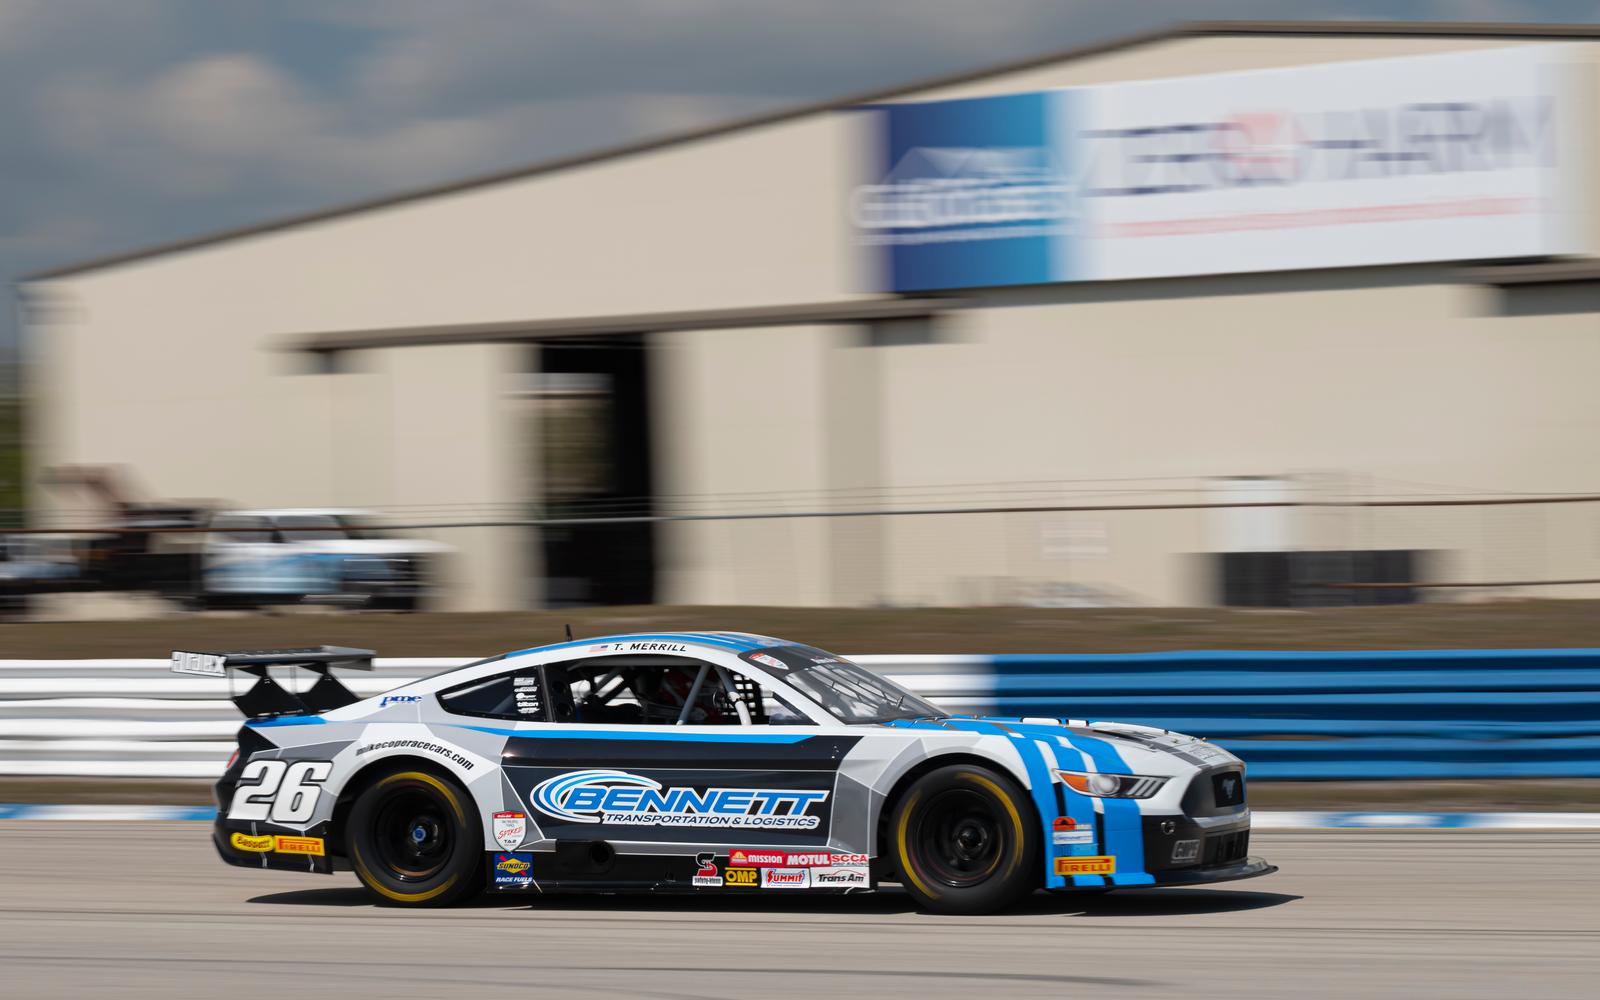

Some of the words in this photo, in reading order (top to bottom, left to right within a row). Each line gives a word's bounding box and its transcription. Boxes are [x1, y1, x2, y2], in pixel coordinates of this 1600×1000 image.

[614, 643, 624, 651] T.
[629, 643, 687, 652] MERRILL
[380, 695, 423, 708] pme
[226, 758, 333, 824] 26
[562, 786, 829, 817] BENNETT
[605, 813, 732, 826] TRANSPORTATION
[732, 816, 742, 825] &
[744, 816, 818, 827] LOGISTICS
[278, 837, 321, 851] PIRELLI
[786, 854, 830, 866] MOTUL
[831, 854, 868, 863] SCCA
[499, 862, 529, 870] SUNOCO
[1057, 858, 1111, 873] PIRELLI
[725, 870, 758, 883] OMP
[818, 873, 845, 883] Trans
[847, 873, 865, 882] Am
